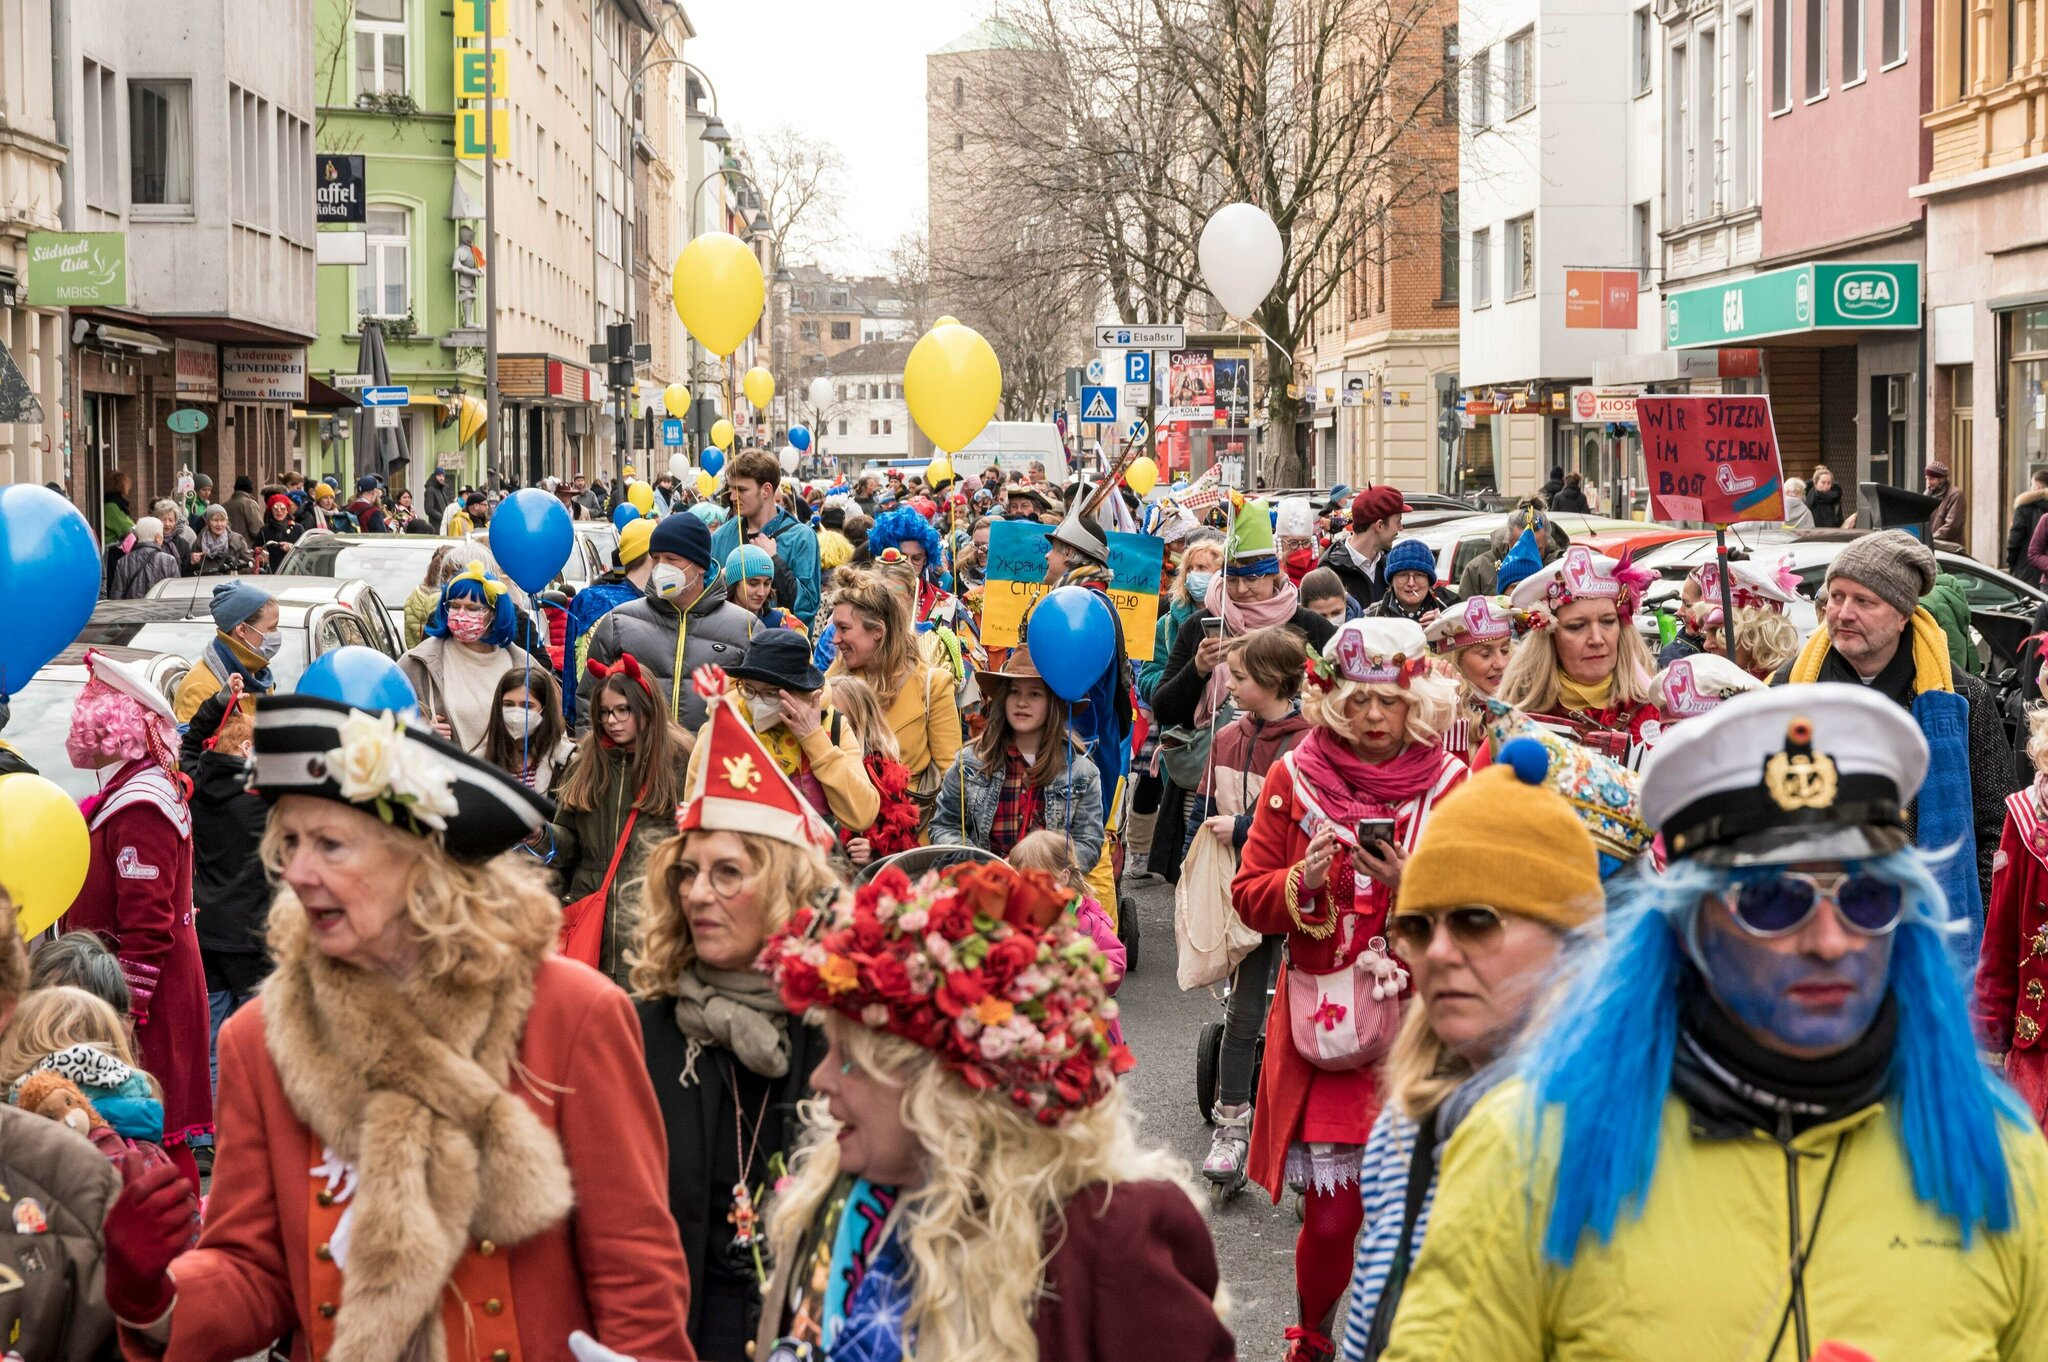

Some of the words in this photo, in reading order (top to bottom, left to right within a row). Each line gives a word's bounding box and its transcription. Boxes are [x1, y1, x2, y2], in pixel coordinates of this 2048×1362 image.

[317, 182, 357, 204] affel
[32, 239, 89, 262] Südstadt
[61, 258, 90, 273] Asia
[57, 286, 100, 299] IMBISS
[1843, 281, 1891, 301] GEA
[1723, 288, 1745, 333] GEA
[1133, 332, 1176, 342] Elsaßstr.
[224, 363, 302, 374] SCHNEIDEREI
[1131, 356, 1145, 380] P
[246, 376, 265, 385] Aller
[267, 376, 280, 385] Art
[223, 387, 257, 398] Damen
[257, 388, 266, 398] &
[268, 388, 302, 398] Herren
[1705, 440, 1770, 463] SELBEN
[1659, 471, 1706, 497] BOOT
[995, 555, 1048, 576] Украин
[1113, 572, 1155, 589] сии:
